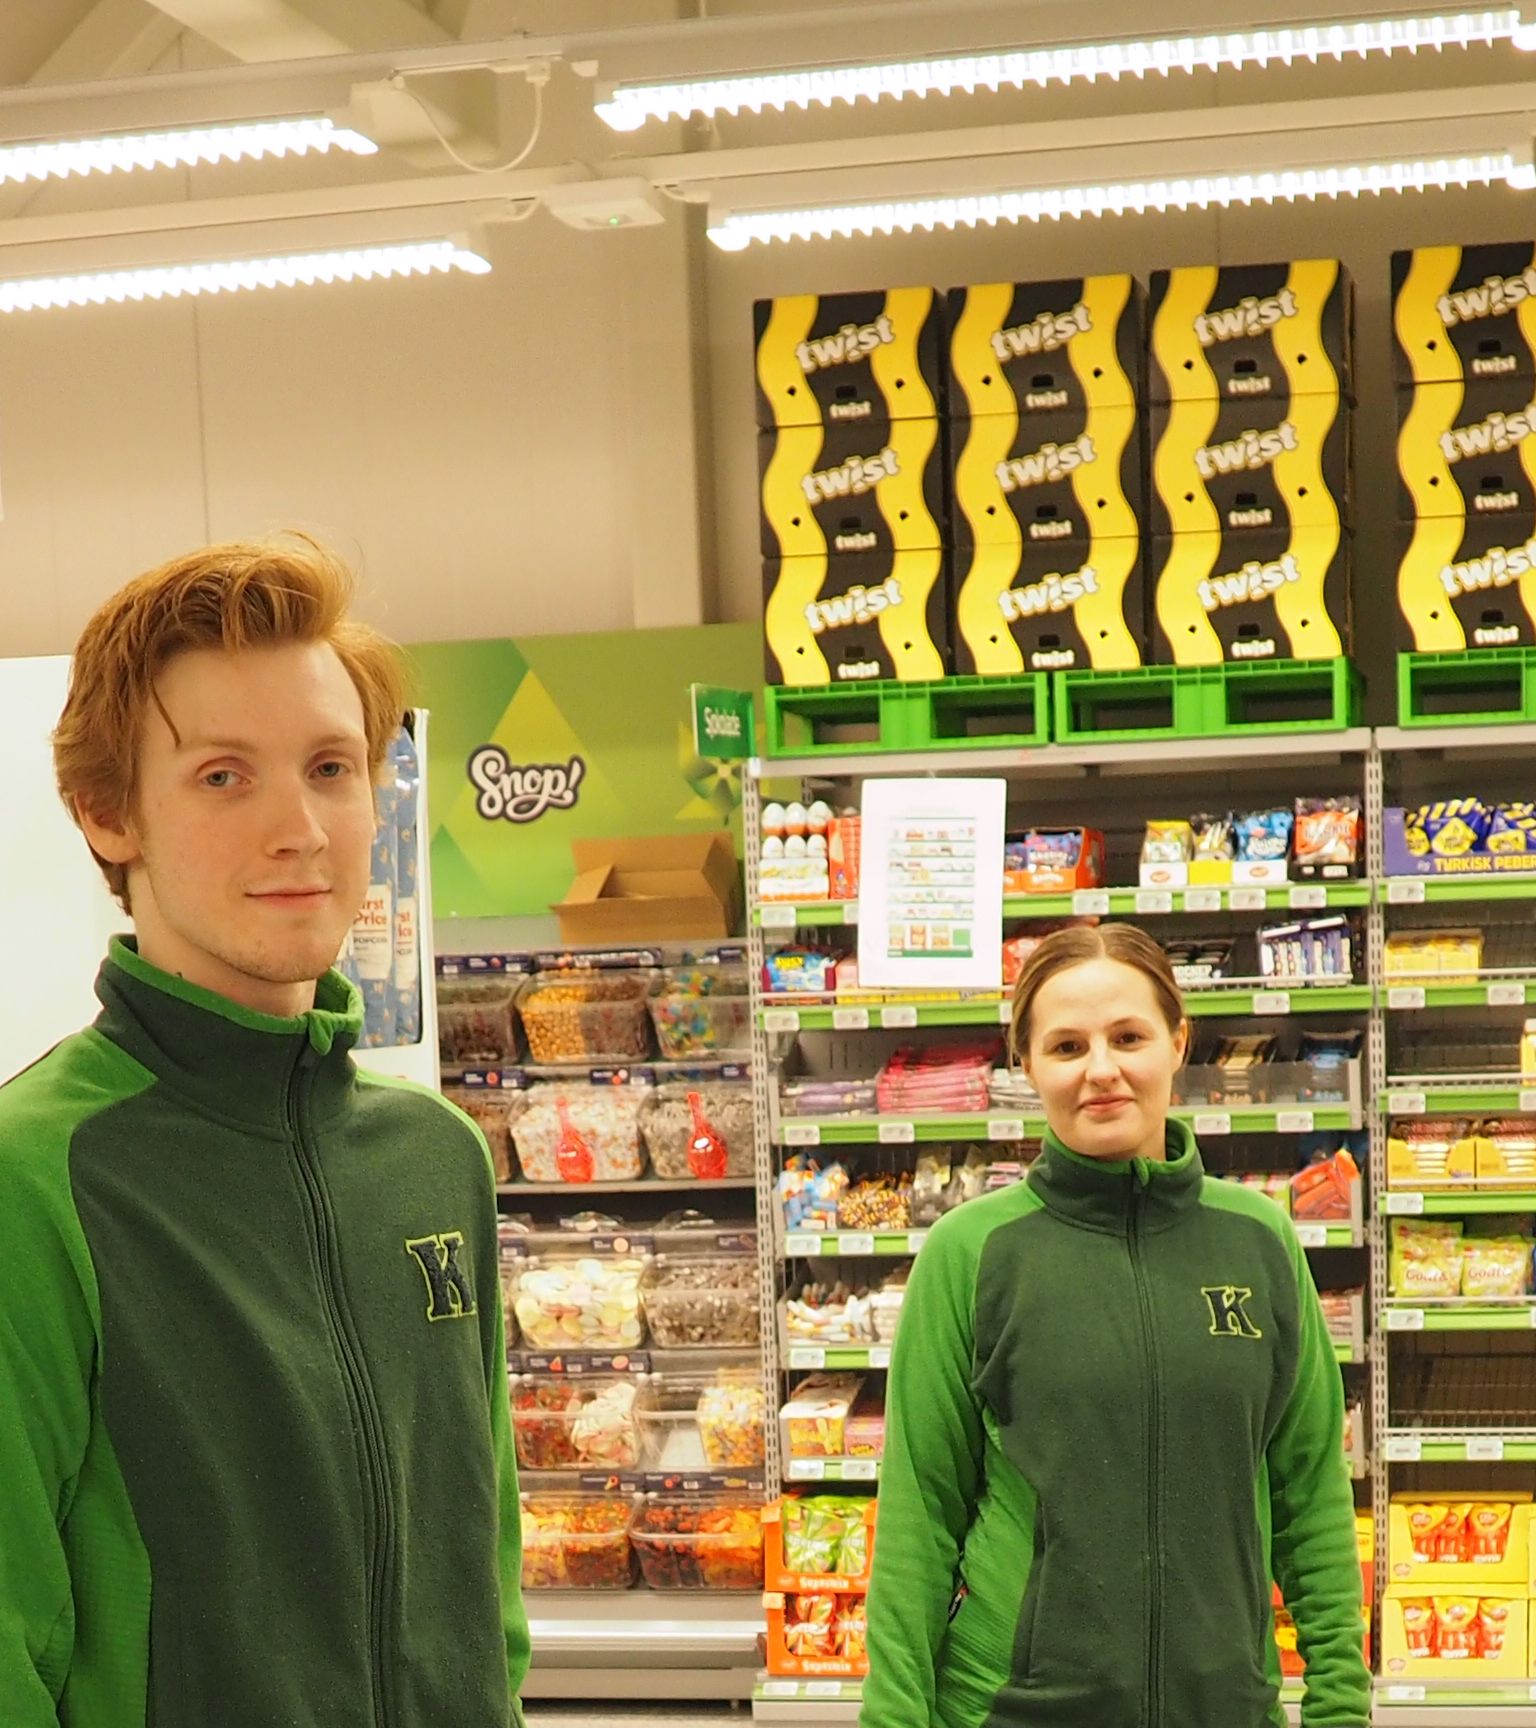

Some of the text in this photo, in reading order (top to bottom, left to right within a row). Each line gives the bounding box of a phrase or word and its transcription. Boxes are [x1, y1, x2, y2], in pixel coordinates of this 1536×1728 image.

[468, 745, 585, 822] Snop!
[405, 1232, 476, 1322] K
[1201, 1285, 1262, 1338] K
